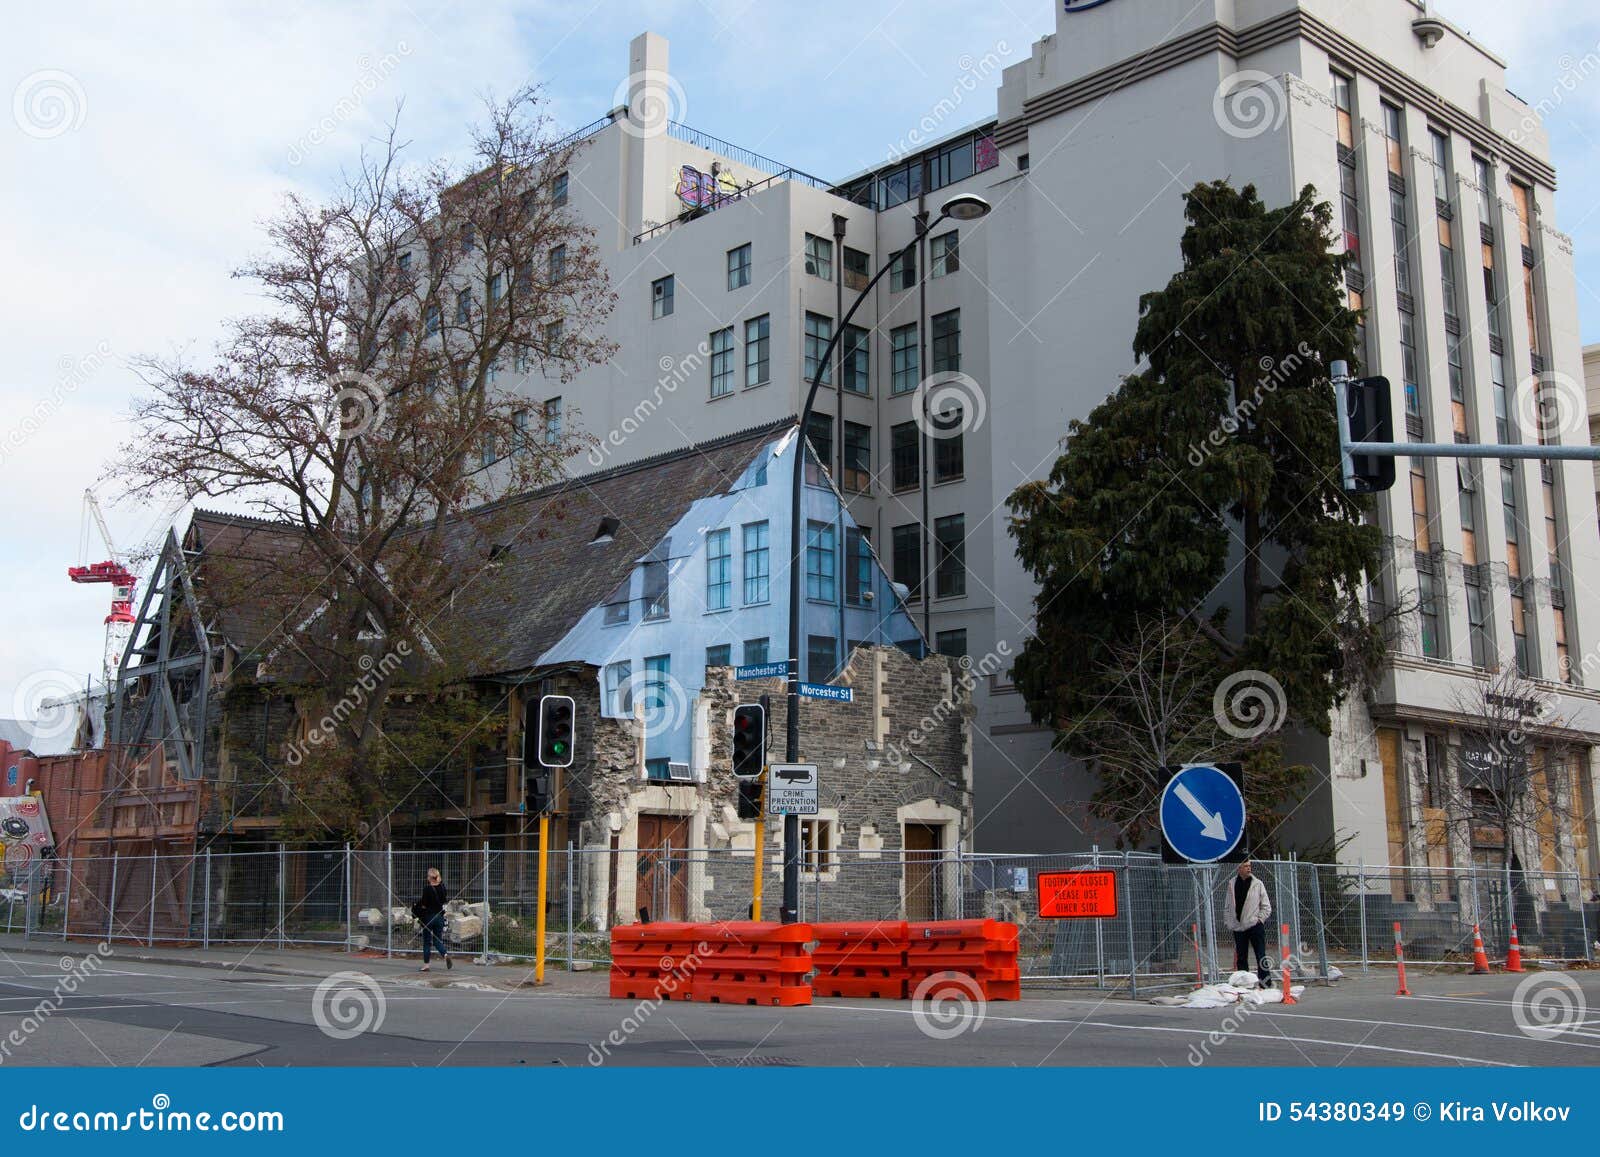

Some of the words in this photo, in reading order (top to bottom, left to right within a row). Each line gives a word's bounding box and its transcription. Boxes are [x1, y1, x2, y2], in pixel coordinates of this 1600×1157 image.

[738, 666, 777, 678] Manchester
[777, 663, 786, 674] St
[801, 684, 839, 698] Worcester
[840, 689, 849, 699] St
[1080, 876, 1108, 887] CLOSED
[1055, 889, 1079, 900] PLEASE
[1084, 889, 1098, 899] USE
[1055, 902, 1078, 913] OTHER
[1081, 902, 1098, 913] SIDE
